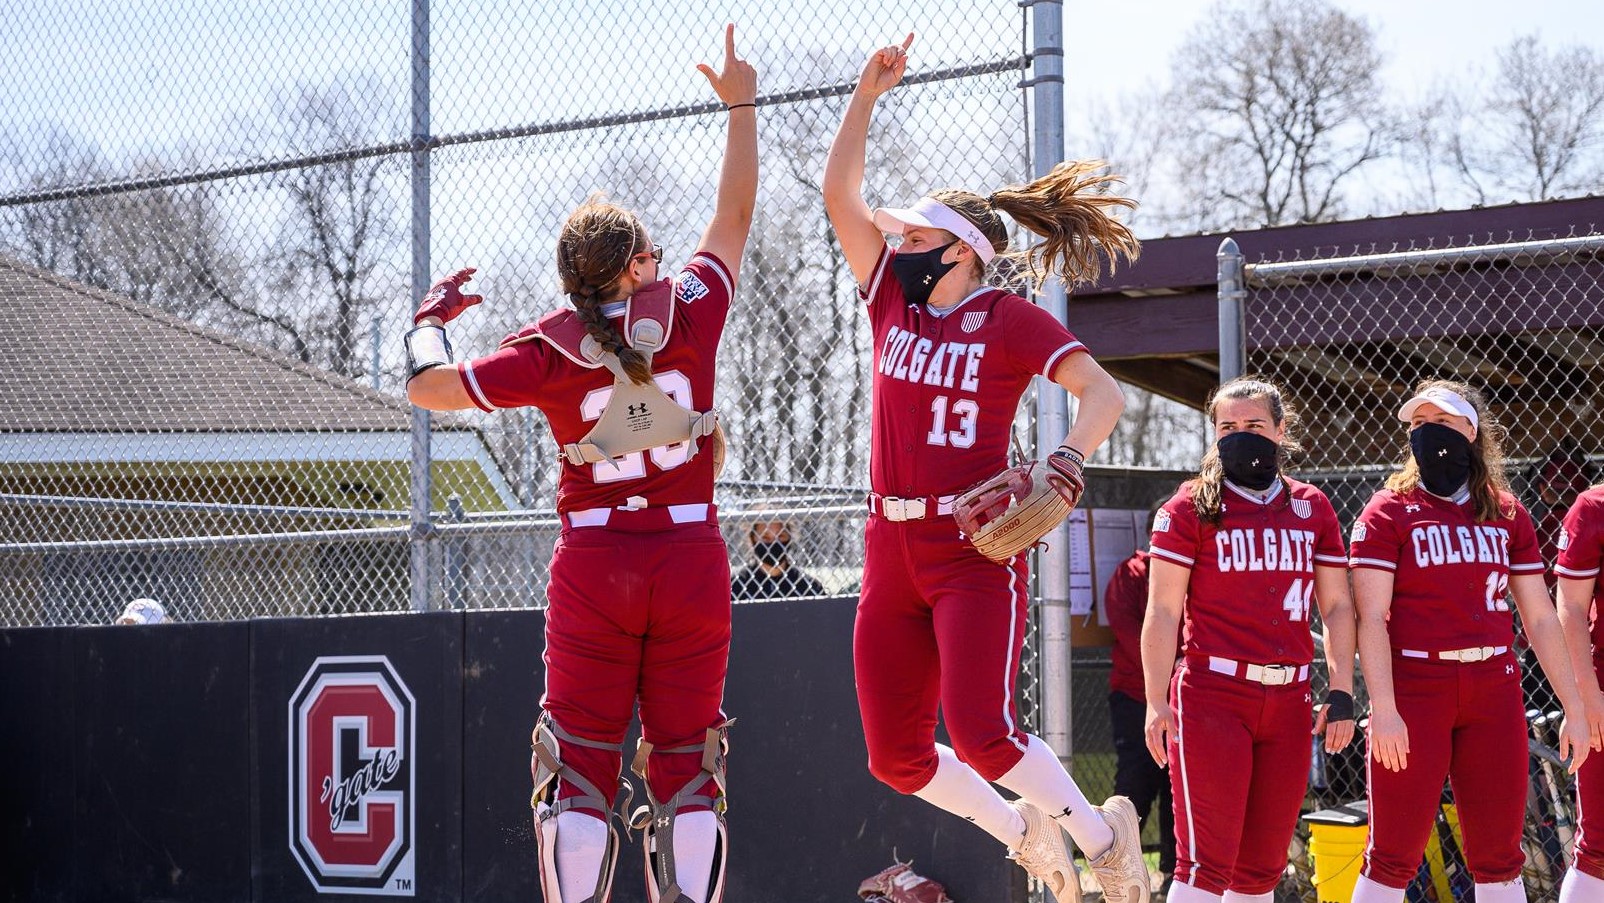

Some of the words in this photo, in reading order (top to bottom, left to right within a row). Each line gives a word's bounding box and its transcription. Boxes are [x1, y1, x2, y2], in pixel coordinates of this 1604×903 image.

[879, 325, 986, 393] COLGATE
[926, 396, 979, 449] 13
[992, 518, 1020, 539] A2000
[1215, 528, 1315, 573] COLGATE
[1412, 525, 1510, 568] COLGATE
[396, 879, 412, 891] TM
